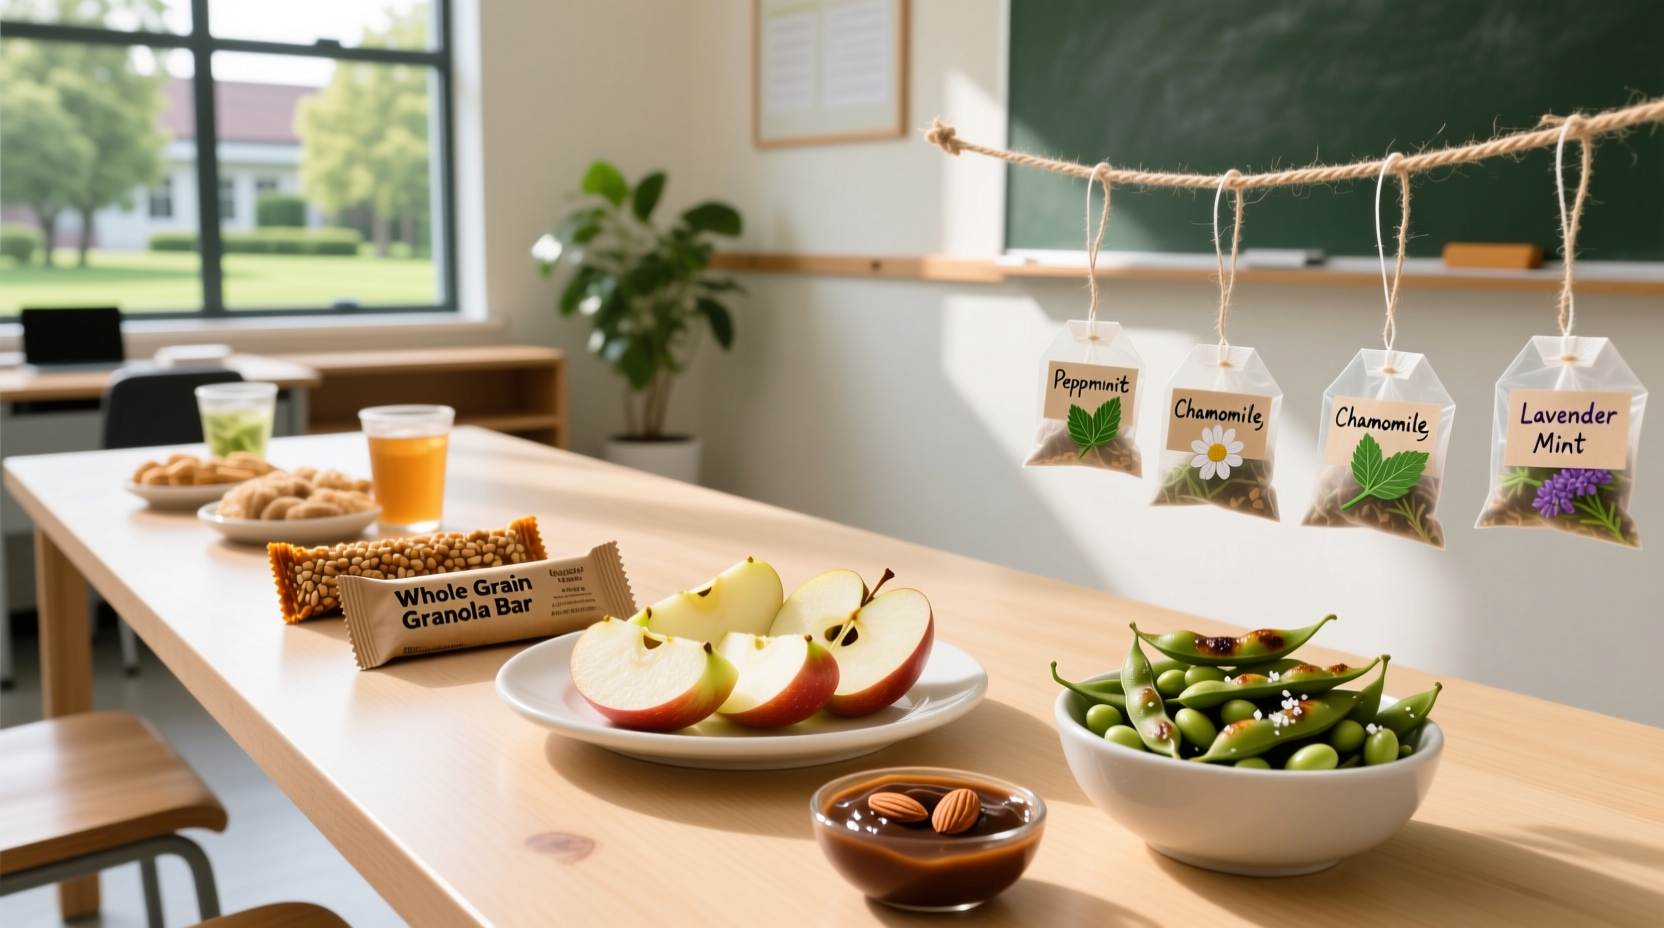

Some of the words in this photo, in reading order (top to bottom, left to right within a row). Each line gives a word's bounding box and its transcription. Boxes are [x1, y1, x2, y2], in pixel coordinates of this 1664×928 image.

[1520, 401, 1618, 424] Lavender
[1532, 431, 1587, 455] Mint
[394, 583, 468, 607] Whole
[473, 574, 533, 597] Grain
[402, 604, 491, 629] Granola
[497, 597, 533, 616] Bar
